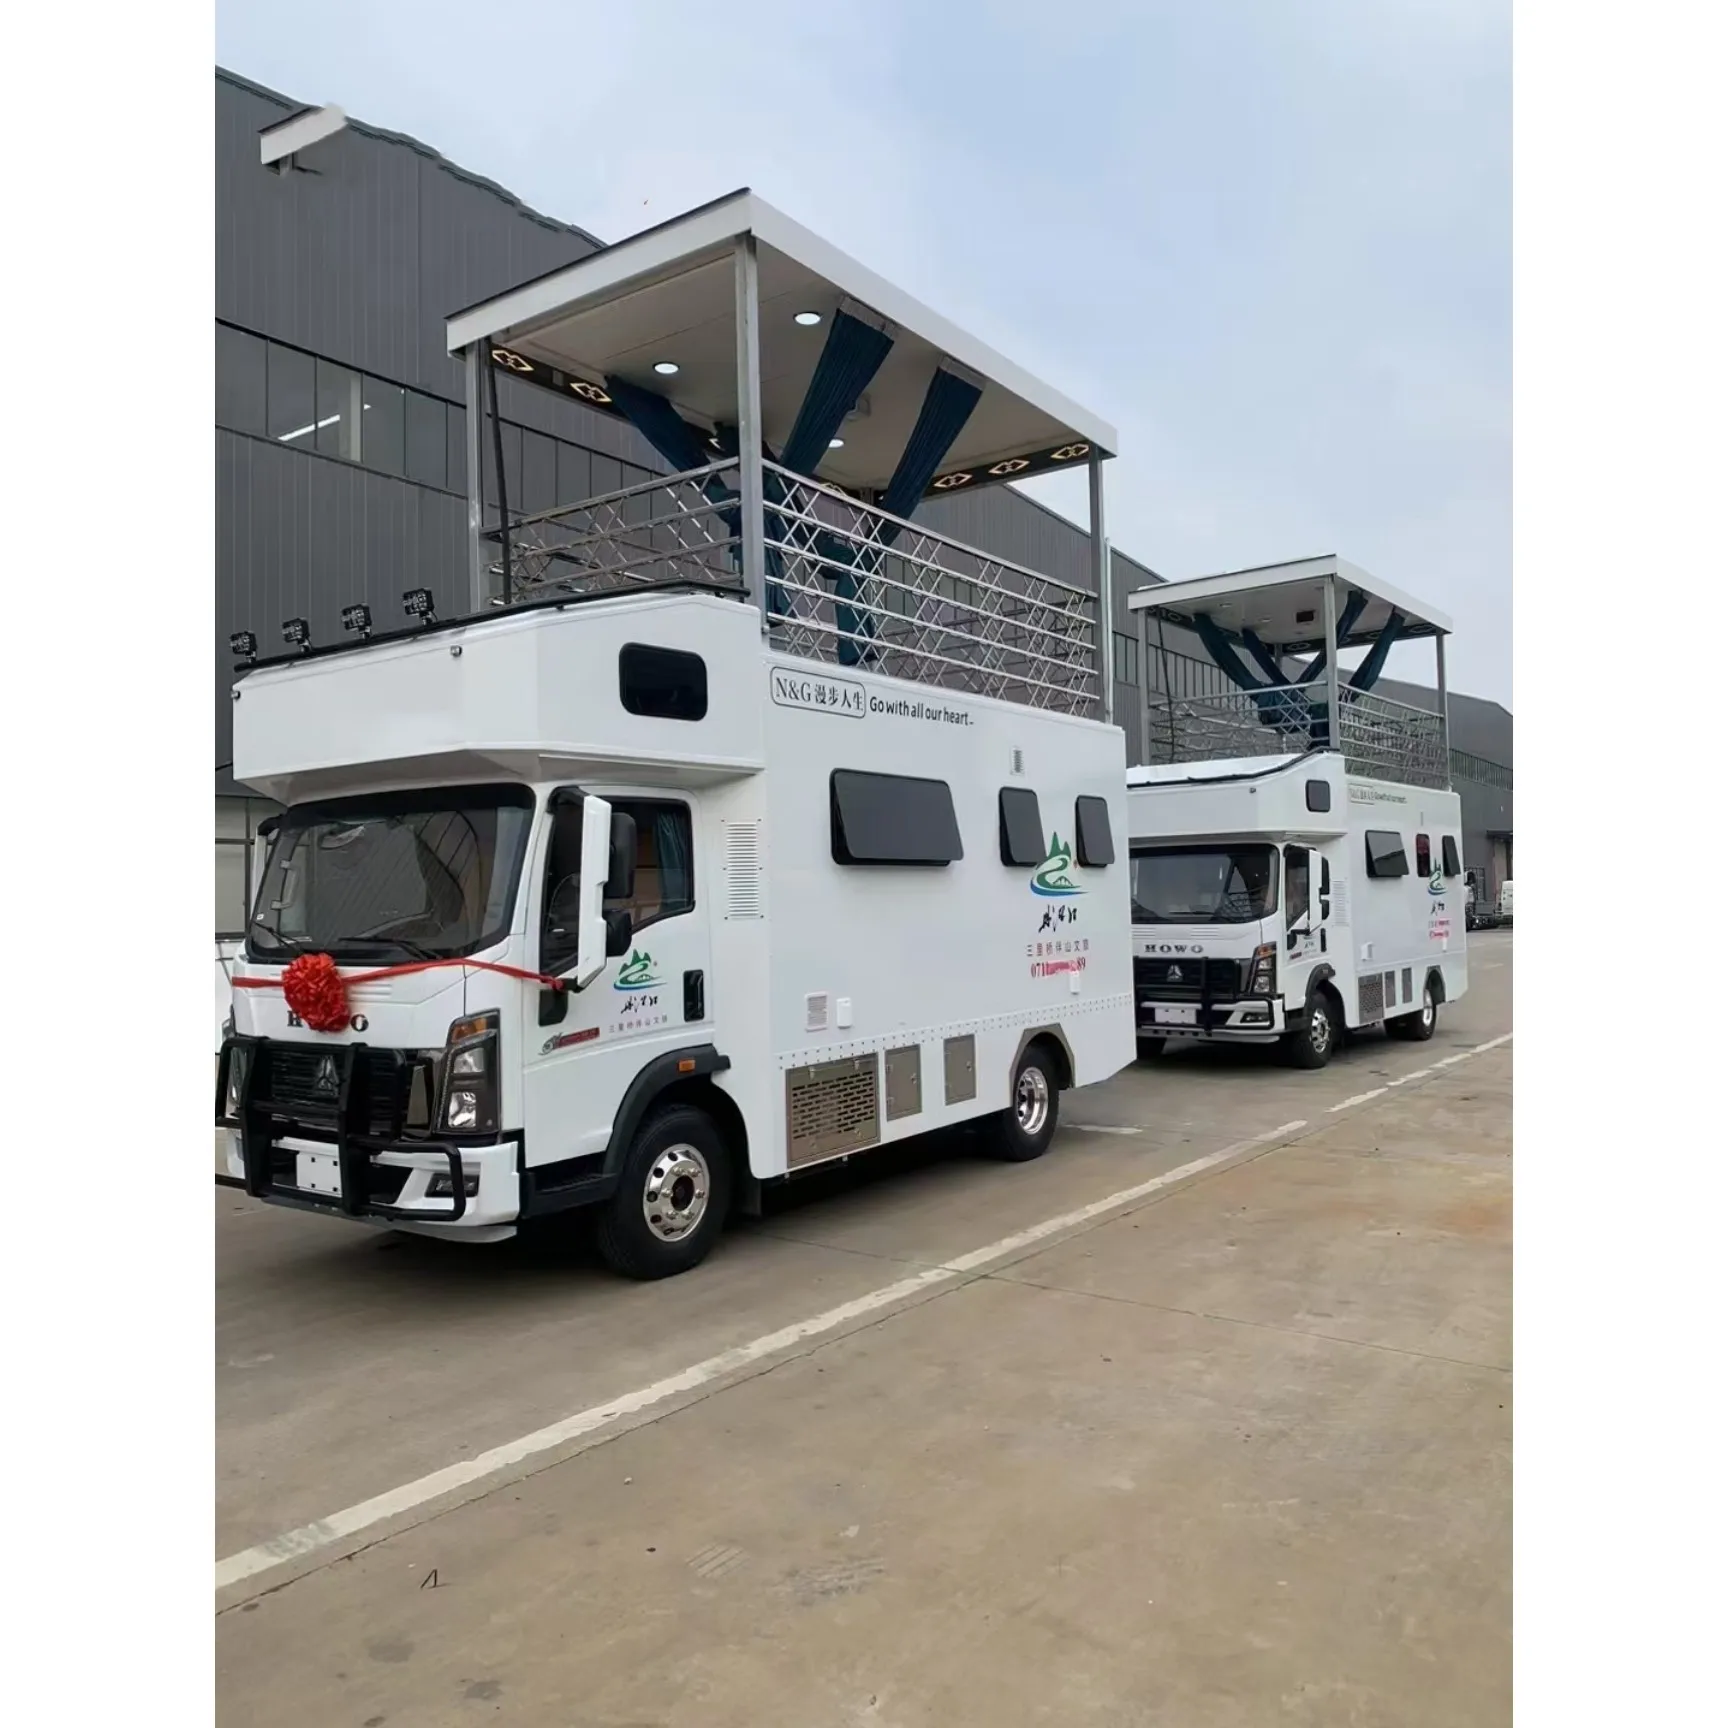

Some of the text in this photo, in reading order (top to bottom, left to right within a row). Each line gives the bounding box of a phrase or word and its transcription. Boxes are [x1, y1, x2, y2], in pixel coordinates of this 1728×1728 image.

[776, 677, 863, 711] N&G 漫步人生
[869, 696, 884, 712] Go
[886, 700, 909, 716] with
[911, 702, 923, 719] all
[925, 707, 942, 721] our
[1144, 944, 1203, 954] HOWO
